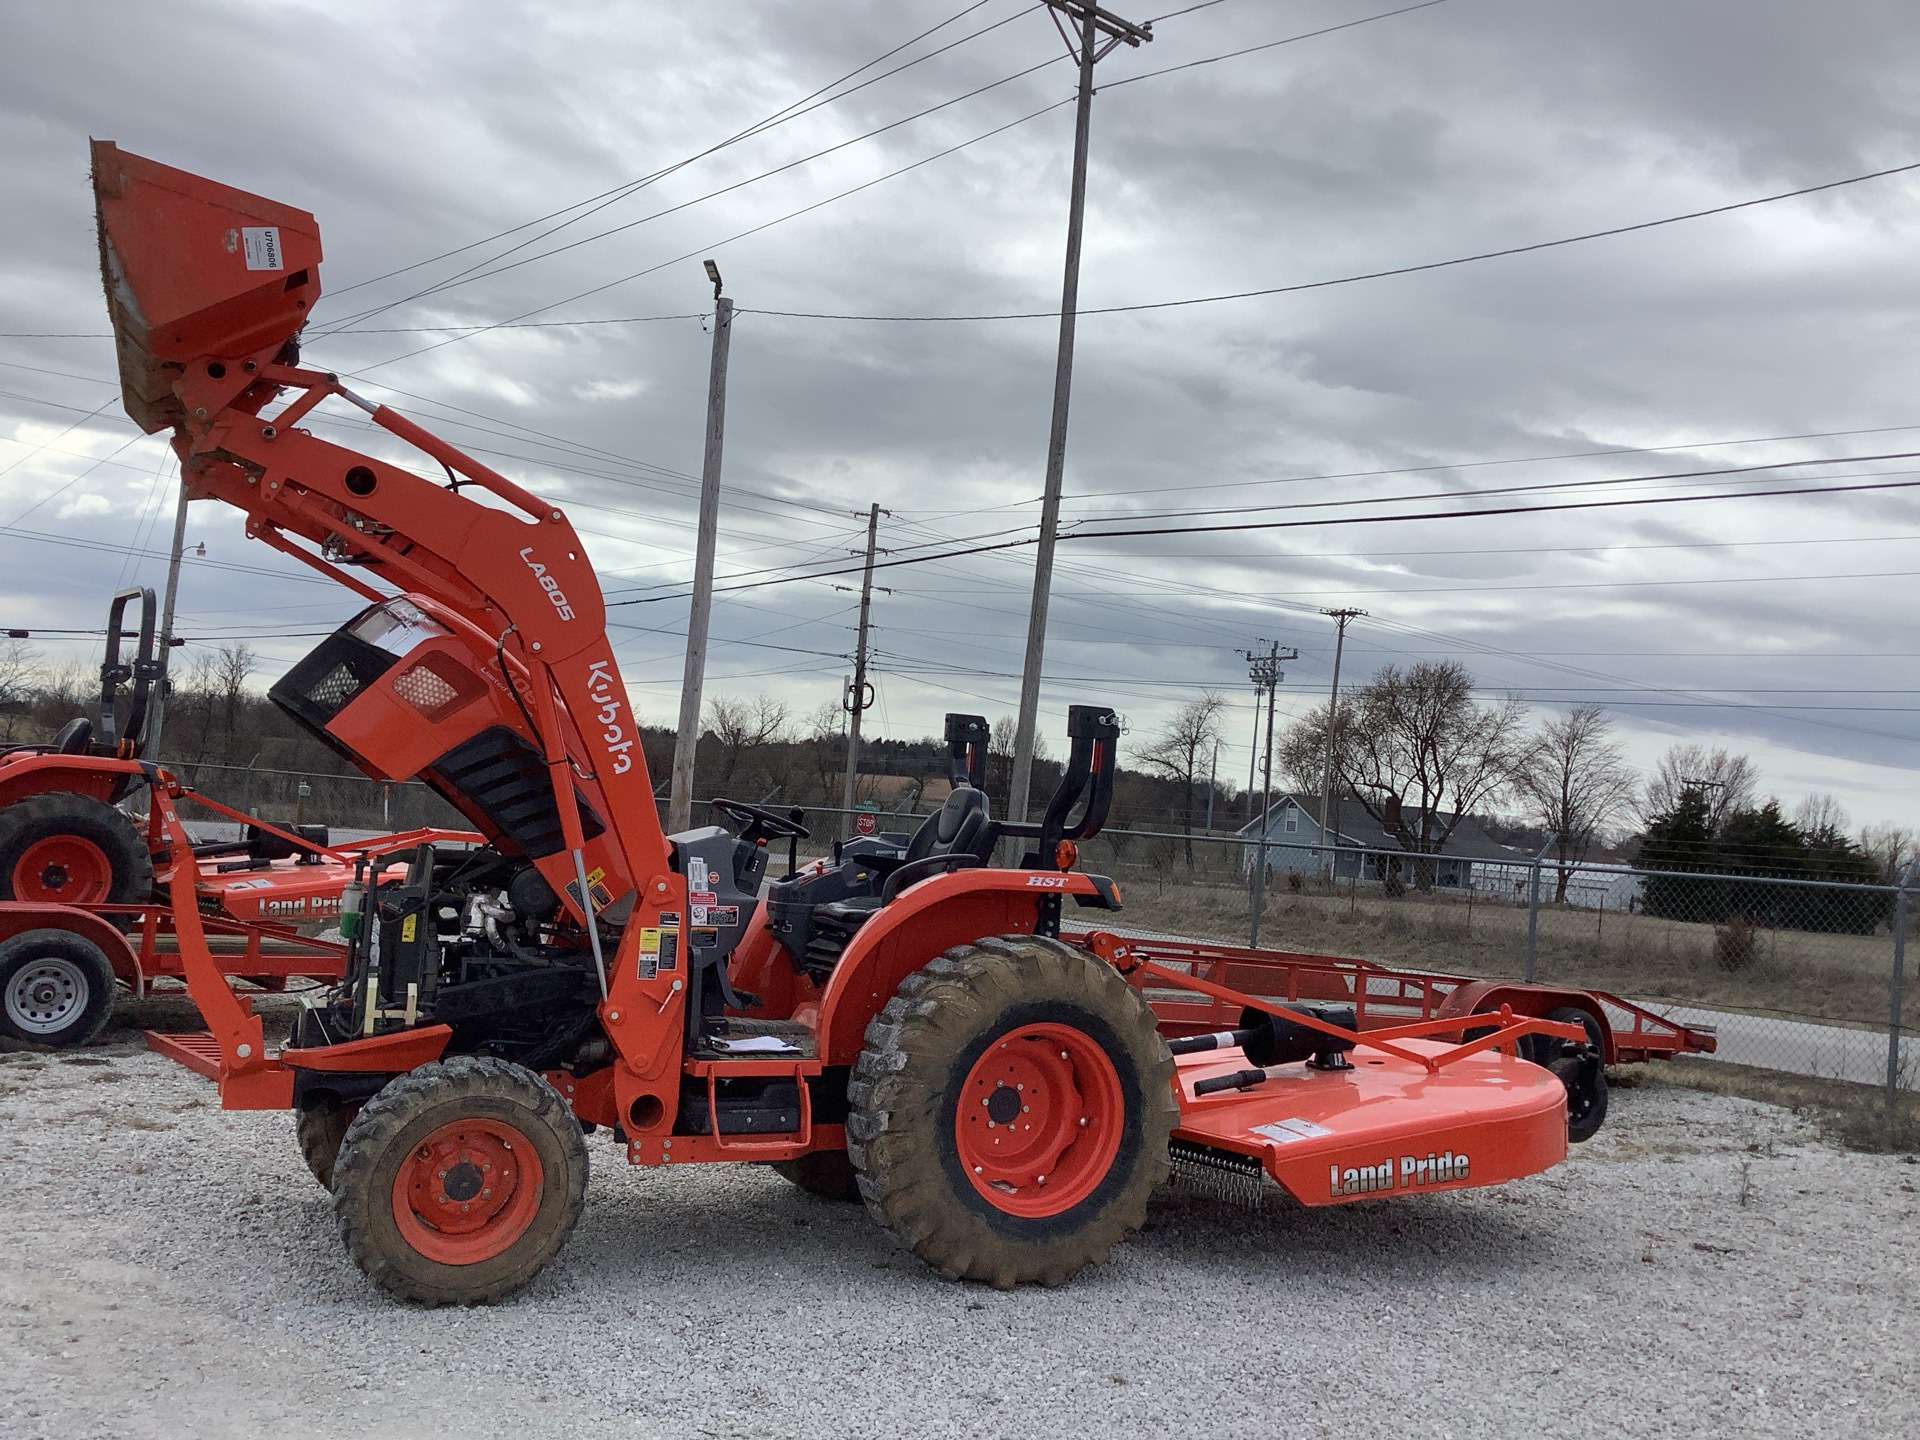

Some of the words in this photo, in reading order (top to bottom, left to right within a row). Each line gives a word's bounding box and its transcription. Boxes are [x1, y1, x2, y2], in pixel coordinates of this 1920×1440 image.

[264, 231, 277, 268] U706806
[519, 546, 576, 622] LA805
[587, 660, 633, 775] Kubota
[858, 818, 875, 828] STOP
[1025, 876, 1069, 888] HST
[259, 896, 306, 917] Land
[1330, 1158, 1394, 1198] Land
[1400, 1150, 1471, 1189] Pride
